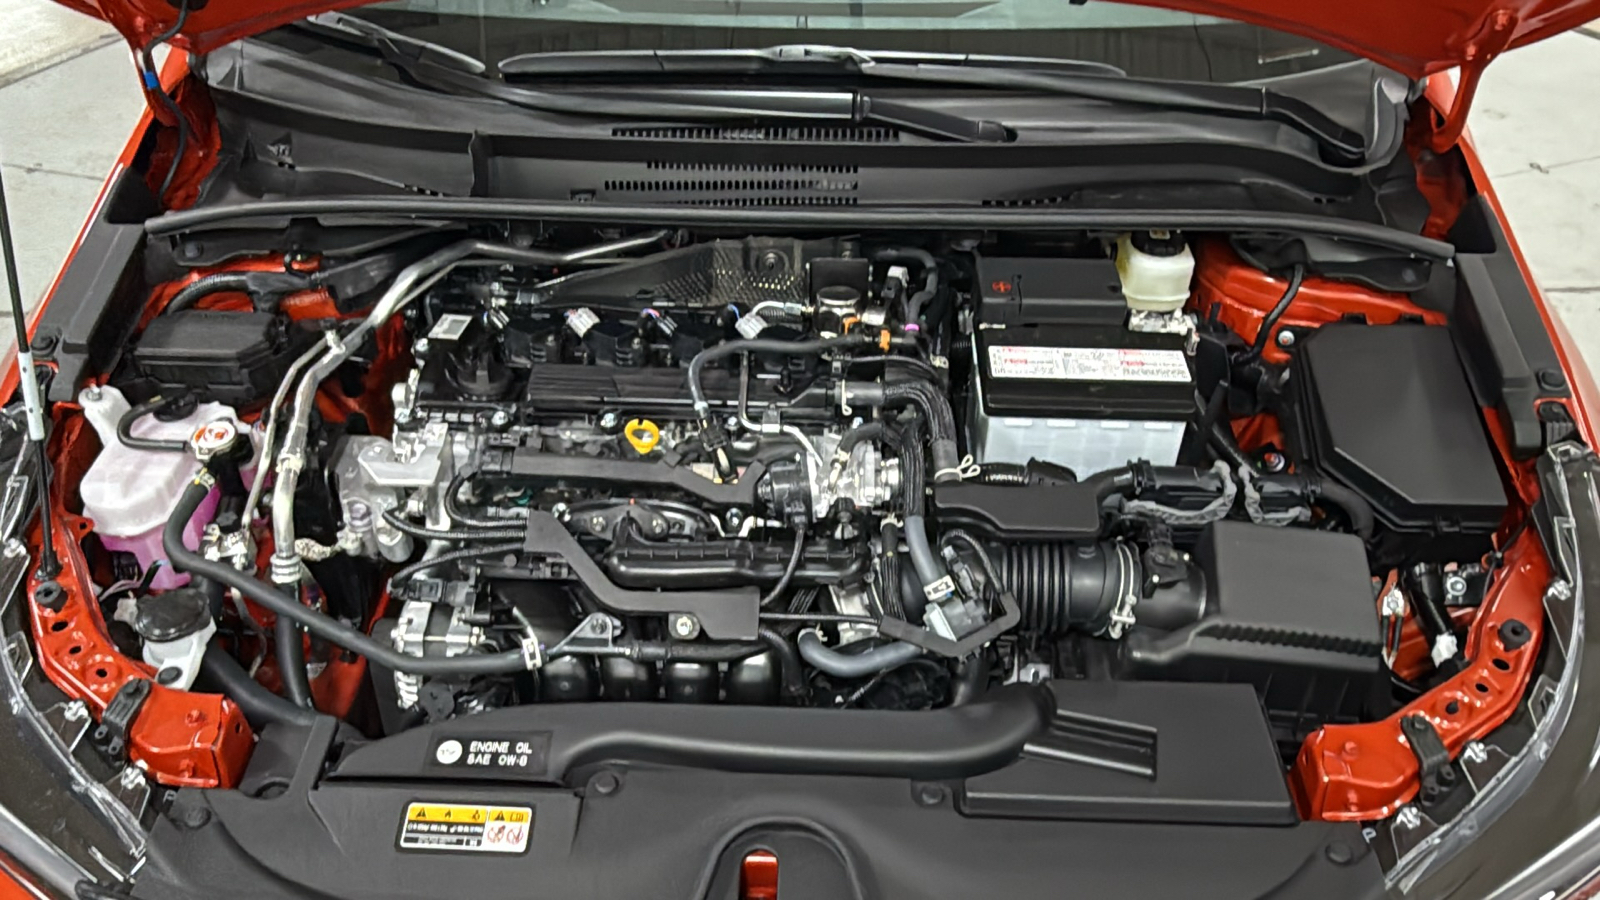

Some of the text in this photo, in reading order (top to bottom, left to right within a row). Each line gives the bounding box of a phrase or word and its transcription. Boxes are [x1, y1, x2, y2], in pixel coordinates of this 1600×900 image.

[470, 740, 510, 753] ENGINE
[515, 742, 532, 754] OIL
[467, 753, 492, 765] SAE
